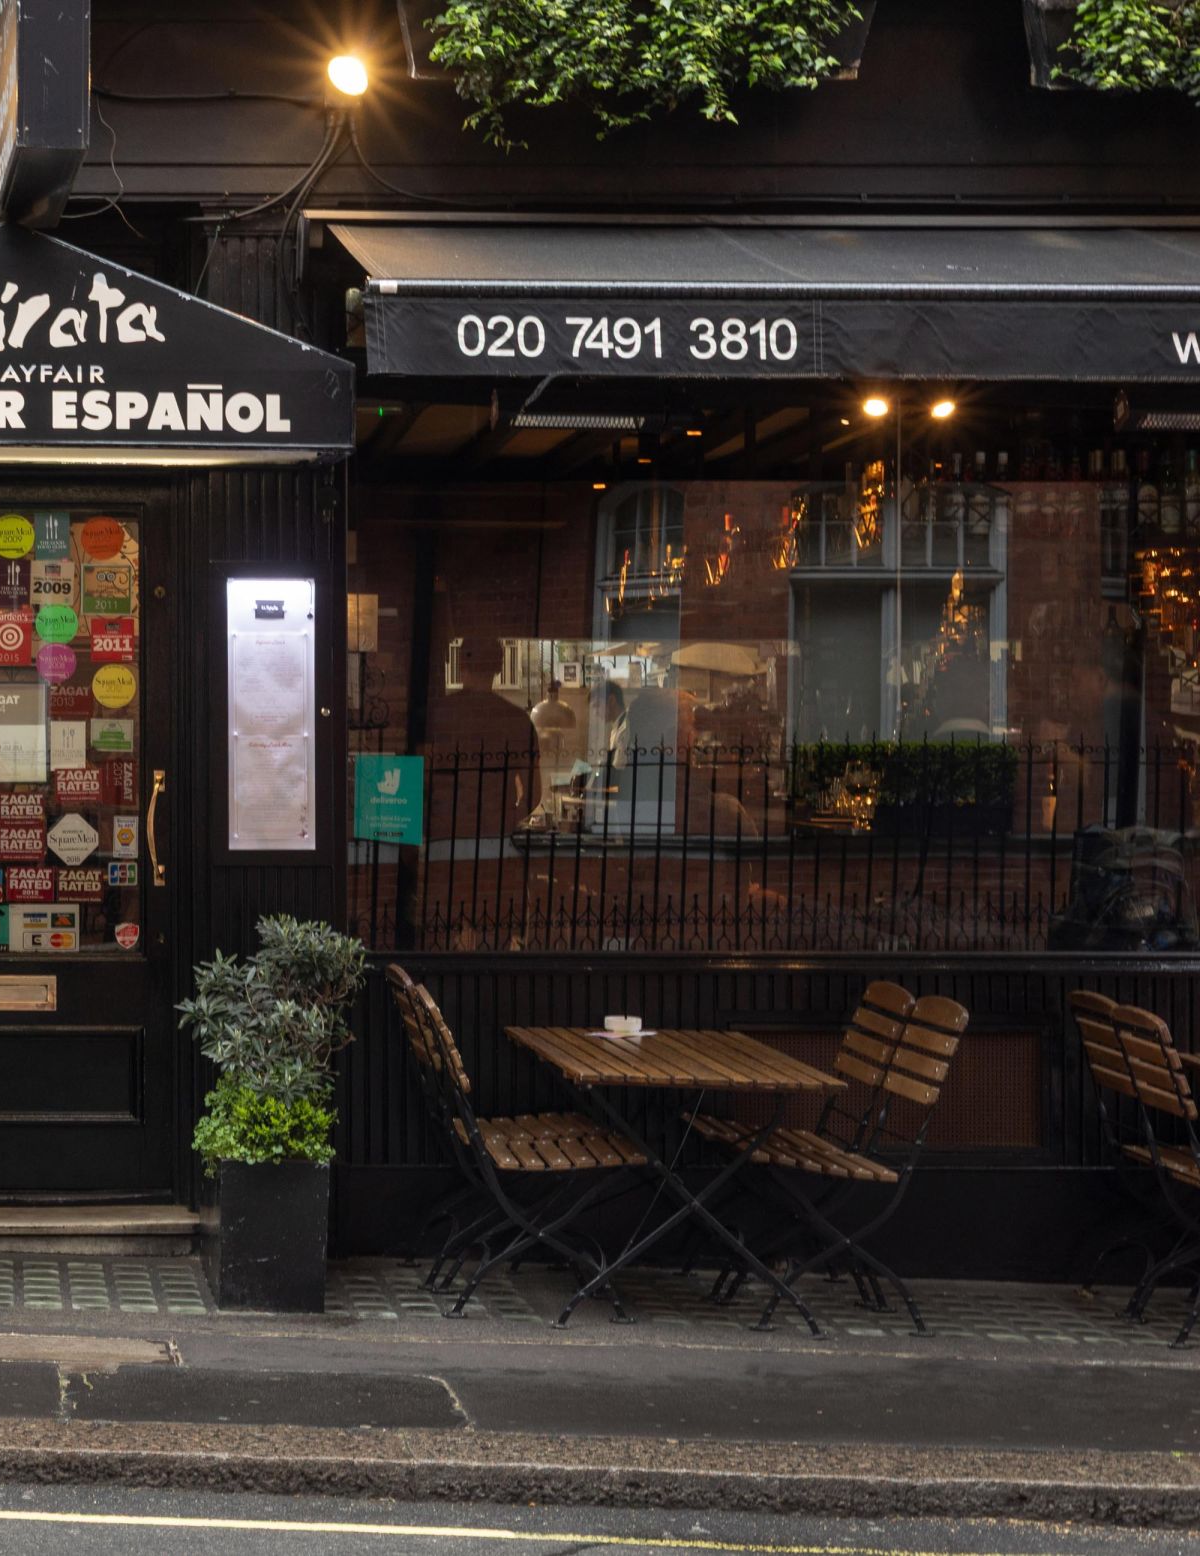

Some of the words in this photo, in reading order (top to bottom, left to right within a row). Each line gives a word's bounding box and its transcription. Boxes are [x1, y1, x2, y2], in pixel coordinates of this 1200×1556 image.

[458, 315, 545, 358] 020
[565, 316, 662, 359] 7491
[689, 318, 798, 361] 3810
[52, 384, 291, 433] ESPAÑOL
[32, 581, 72, 595] 2009
[95, 600, 118, 610] 2011
[92, 638, 133, 652] 2011
[0, 653, 20, 662] 2015
[50, 686, 89, 697] ZAGAT
[57, 770, 100, 781] ZAGAT
[57, 781, 100, 791] RATED
[123, 762, 133, 801] ZAGAT
[0, 794, 43, 805] ZAGAT
[0, 805, 43, 816] RATED
[0, 829, 43, 839] ZAGAT
[0, 840, 43, 850] RATED
[9, 868, 52, 879] ZAGAT
[59, 870, 102, 881] ZAGAT
[9, 879, 52, 890] RATED
[59, 881, 102, 892] RATED
